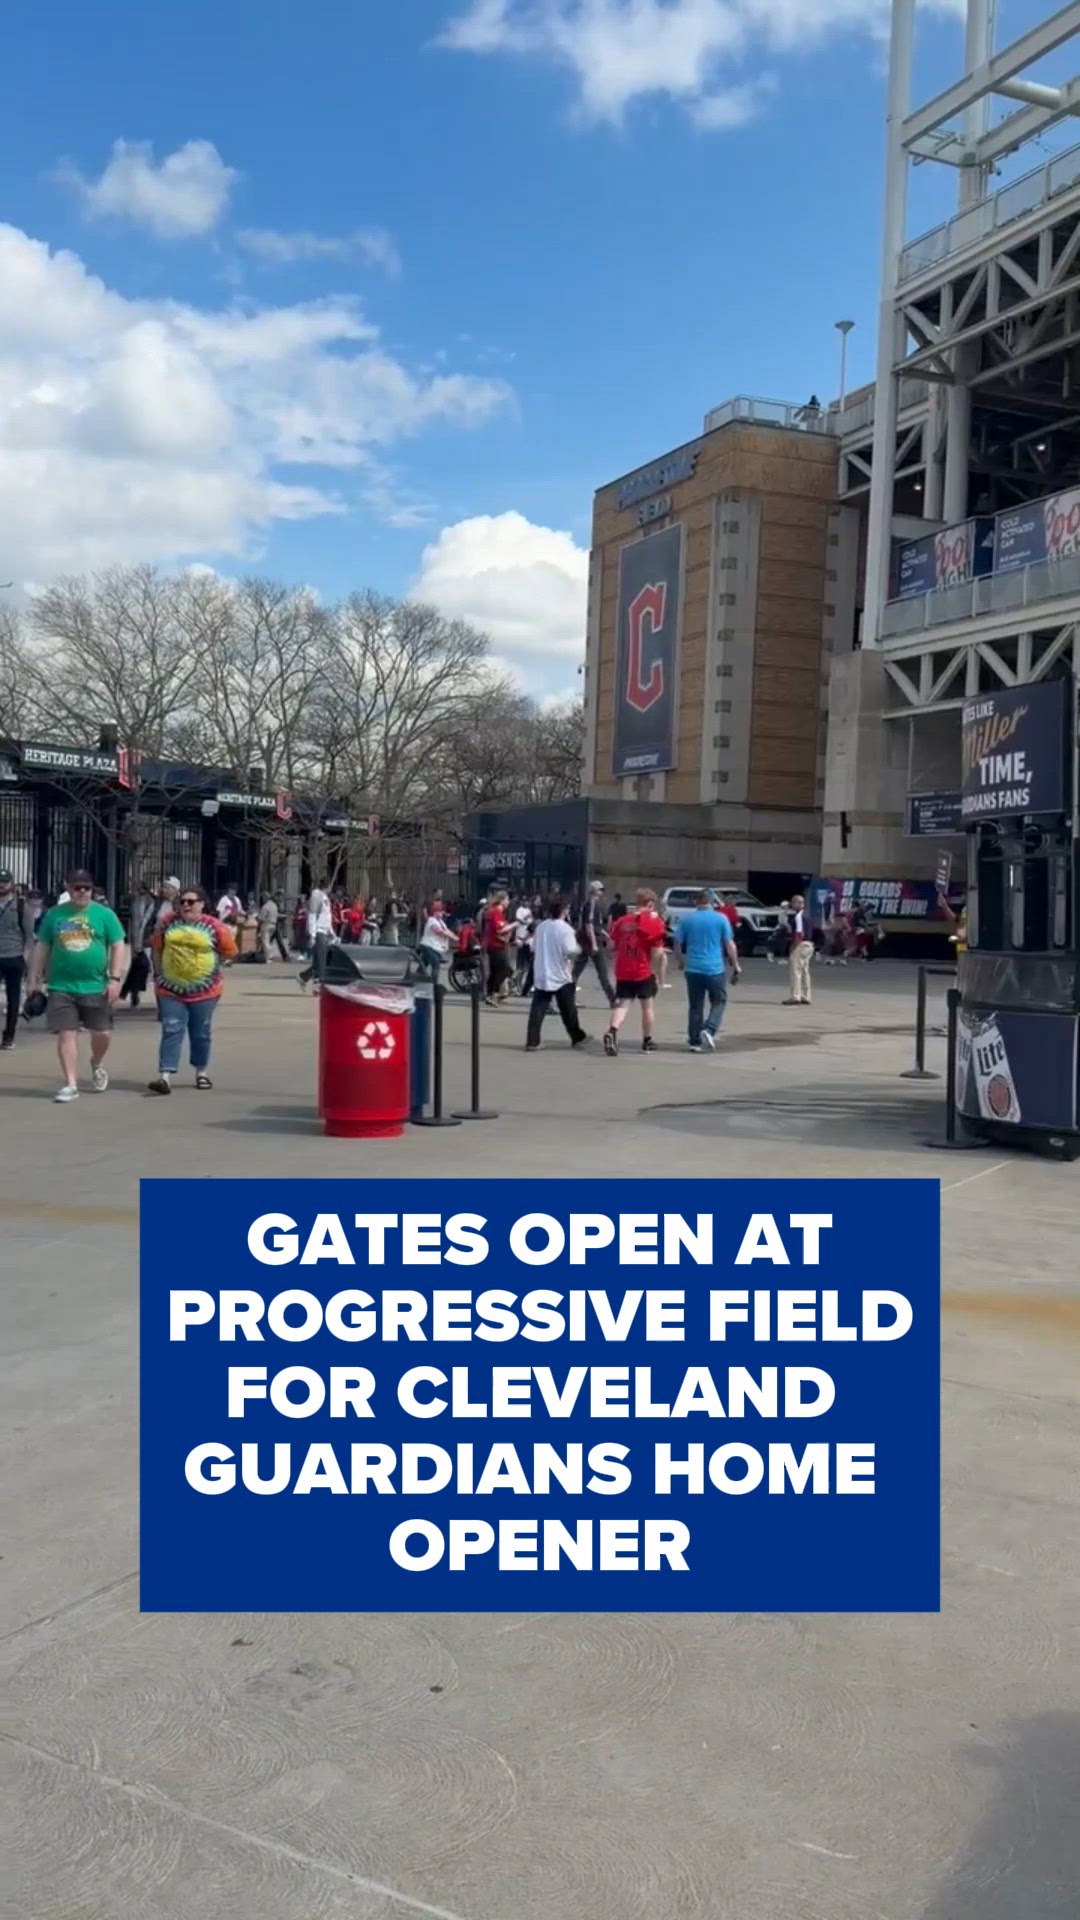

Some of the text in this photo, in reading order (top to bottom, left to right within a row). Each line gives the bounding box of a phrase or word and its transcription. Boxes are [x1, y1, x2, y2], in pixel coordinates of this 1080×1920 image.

[627, 582, 668, 713] C
[976, 700, 994, 719] LIKE
[24, 748, 118, 773] HERITAGE PLAZA
[979, 751, 1033, 786] TIME,
[998, 788, 1030, 809] FANS
[977, 1040, 1004, 1077] Lite
